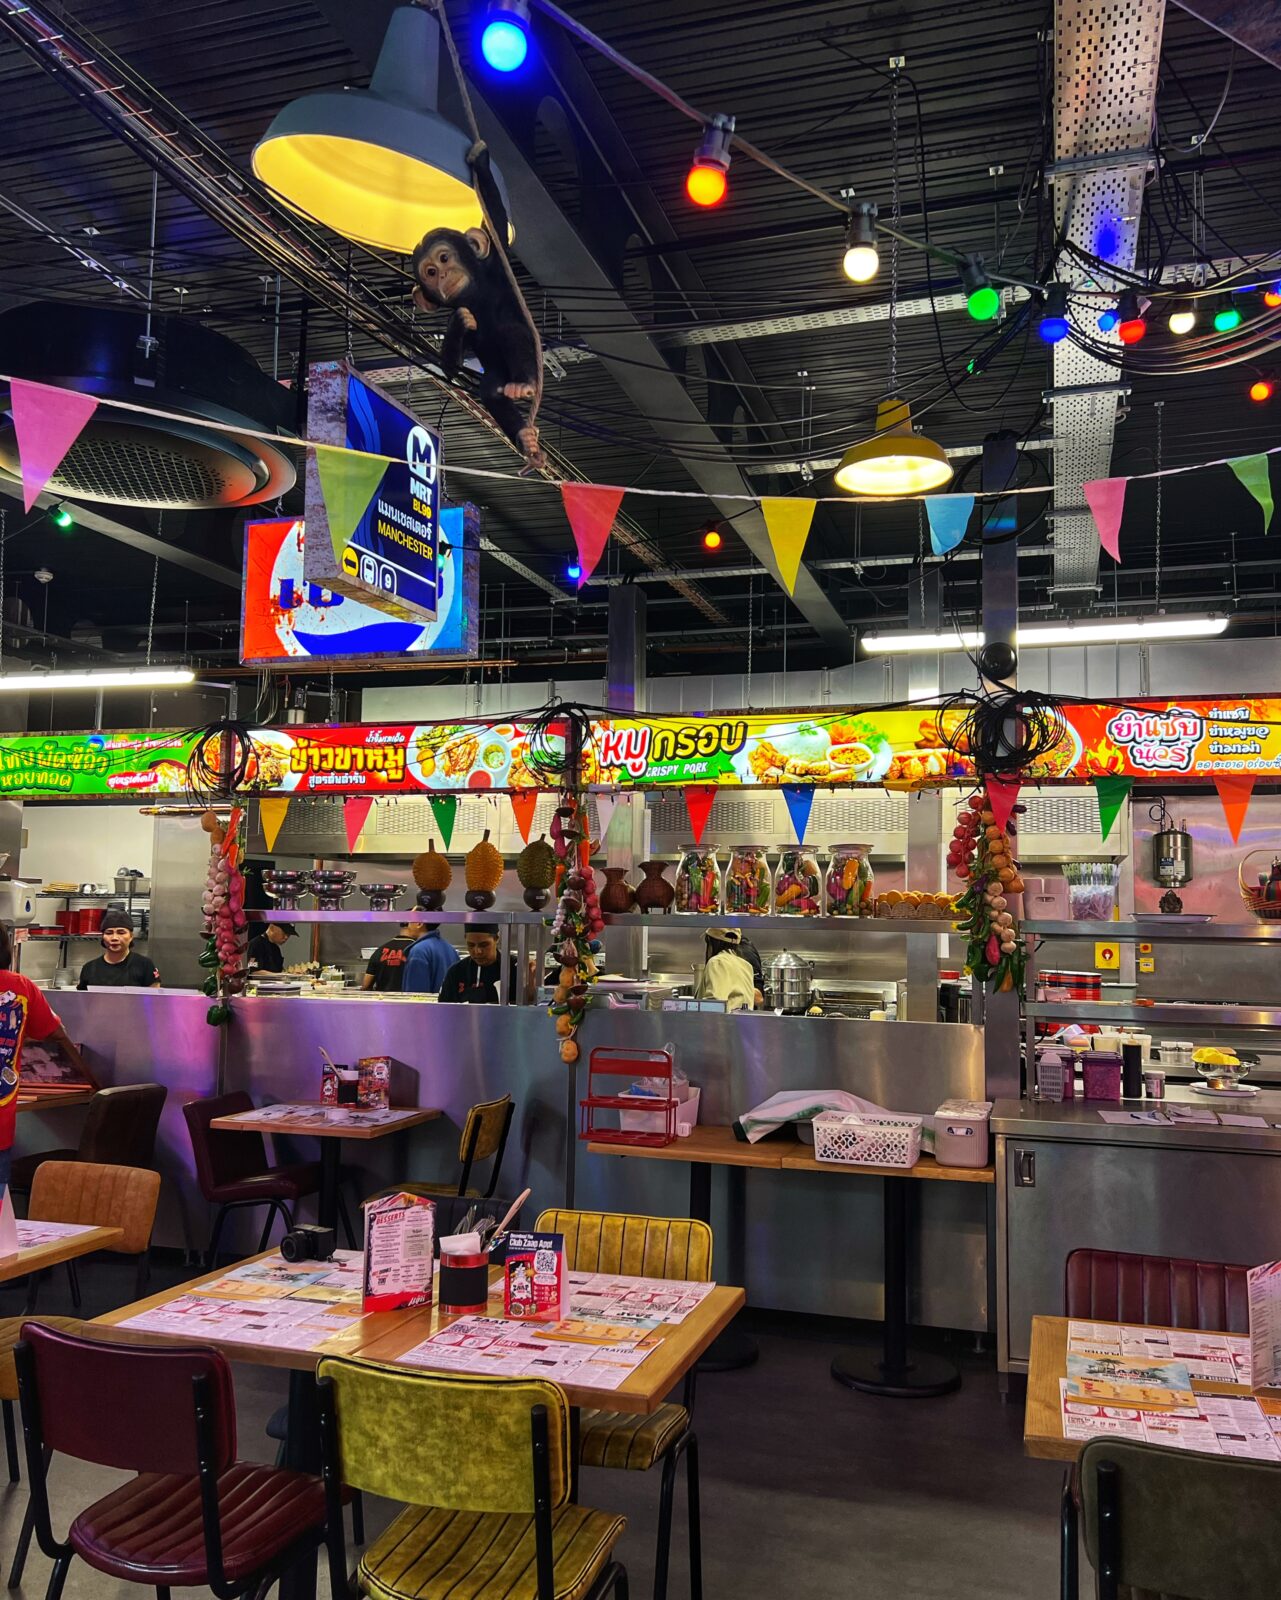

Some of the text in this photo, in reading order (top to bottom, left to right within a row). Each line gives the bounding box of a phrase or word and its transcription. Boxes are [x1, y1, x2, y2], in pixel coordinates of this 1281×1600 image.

[410, 477, 433, 505] MRT
[413, 498, 433, 519] BL99
[378, 519, 433, 561] MANCHESTER
[384, 576, 392, 588] 9
[599, 721, 748, 777] หมู กรอบ
[290, 737, 405, 782] ข้าวขาหมู
[646, 761, 709, 778] CRISPY PORK
[1, 770, 72, 787] หอยทอด
[375, 1211, 406, 1226] DESSERTS
[509, 1238, 523, 1247] Club
[523, 1239, 539, 1248] Zaap
[471, 1316, 510, 1326] ZAAP
